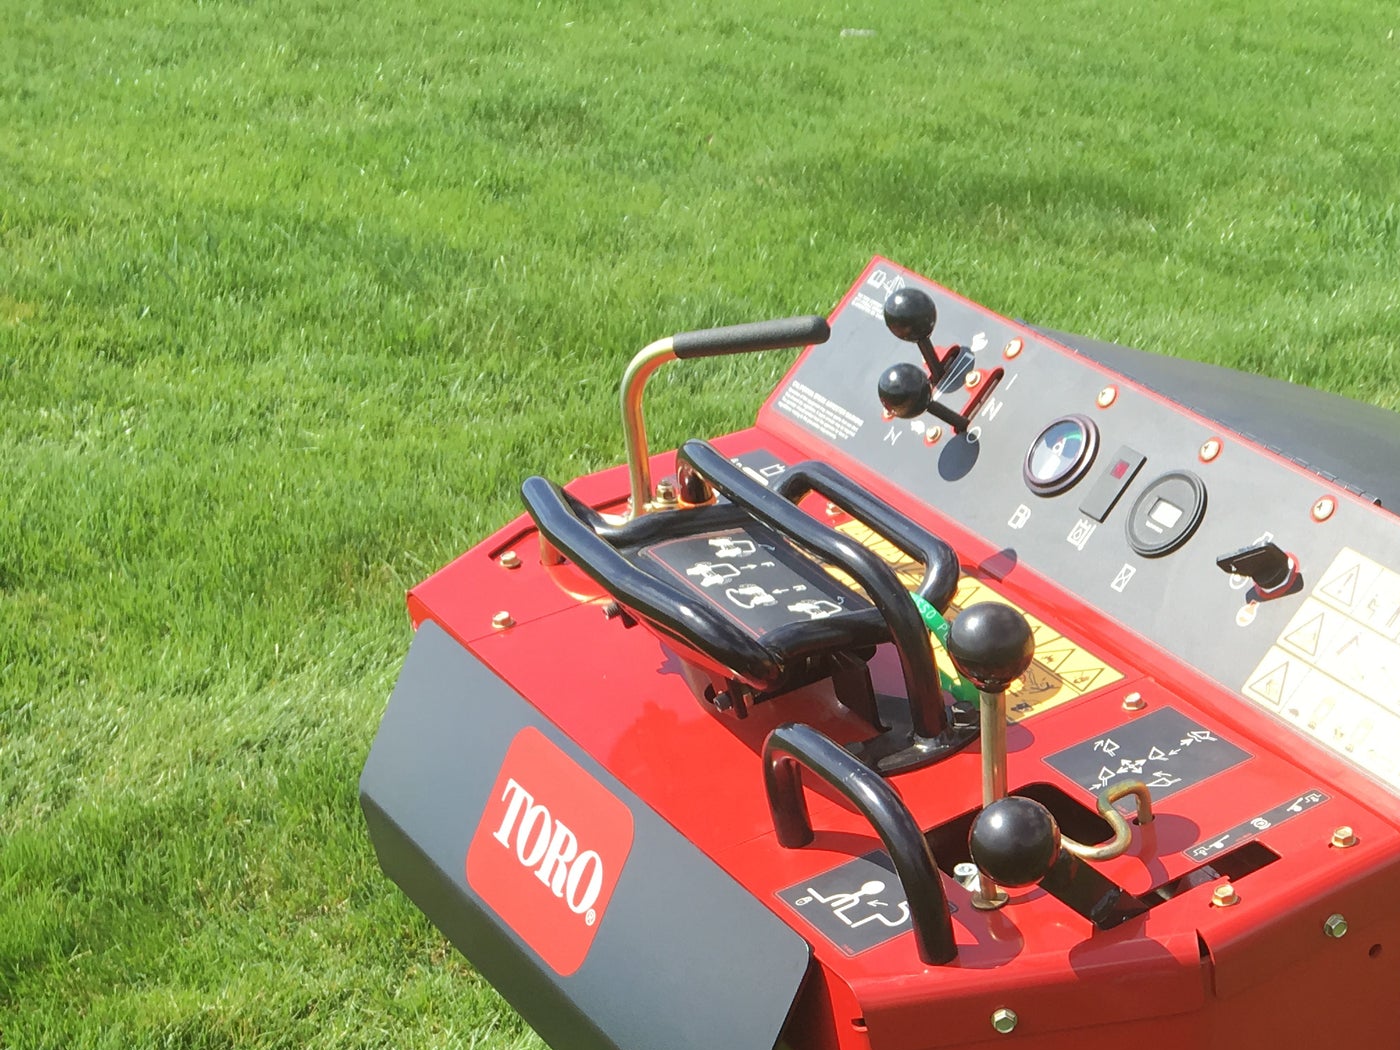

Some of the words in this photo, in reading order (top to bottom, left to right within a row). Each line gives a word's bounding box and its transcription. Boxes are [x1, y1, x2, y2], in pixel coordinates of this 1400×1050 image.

[981, 396, 1003, 421] N
[883, 426, 903, 446] N
[492, 777, 603, 915] TORO
